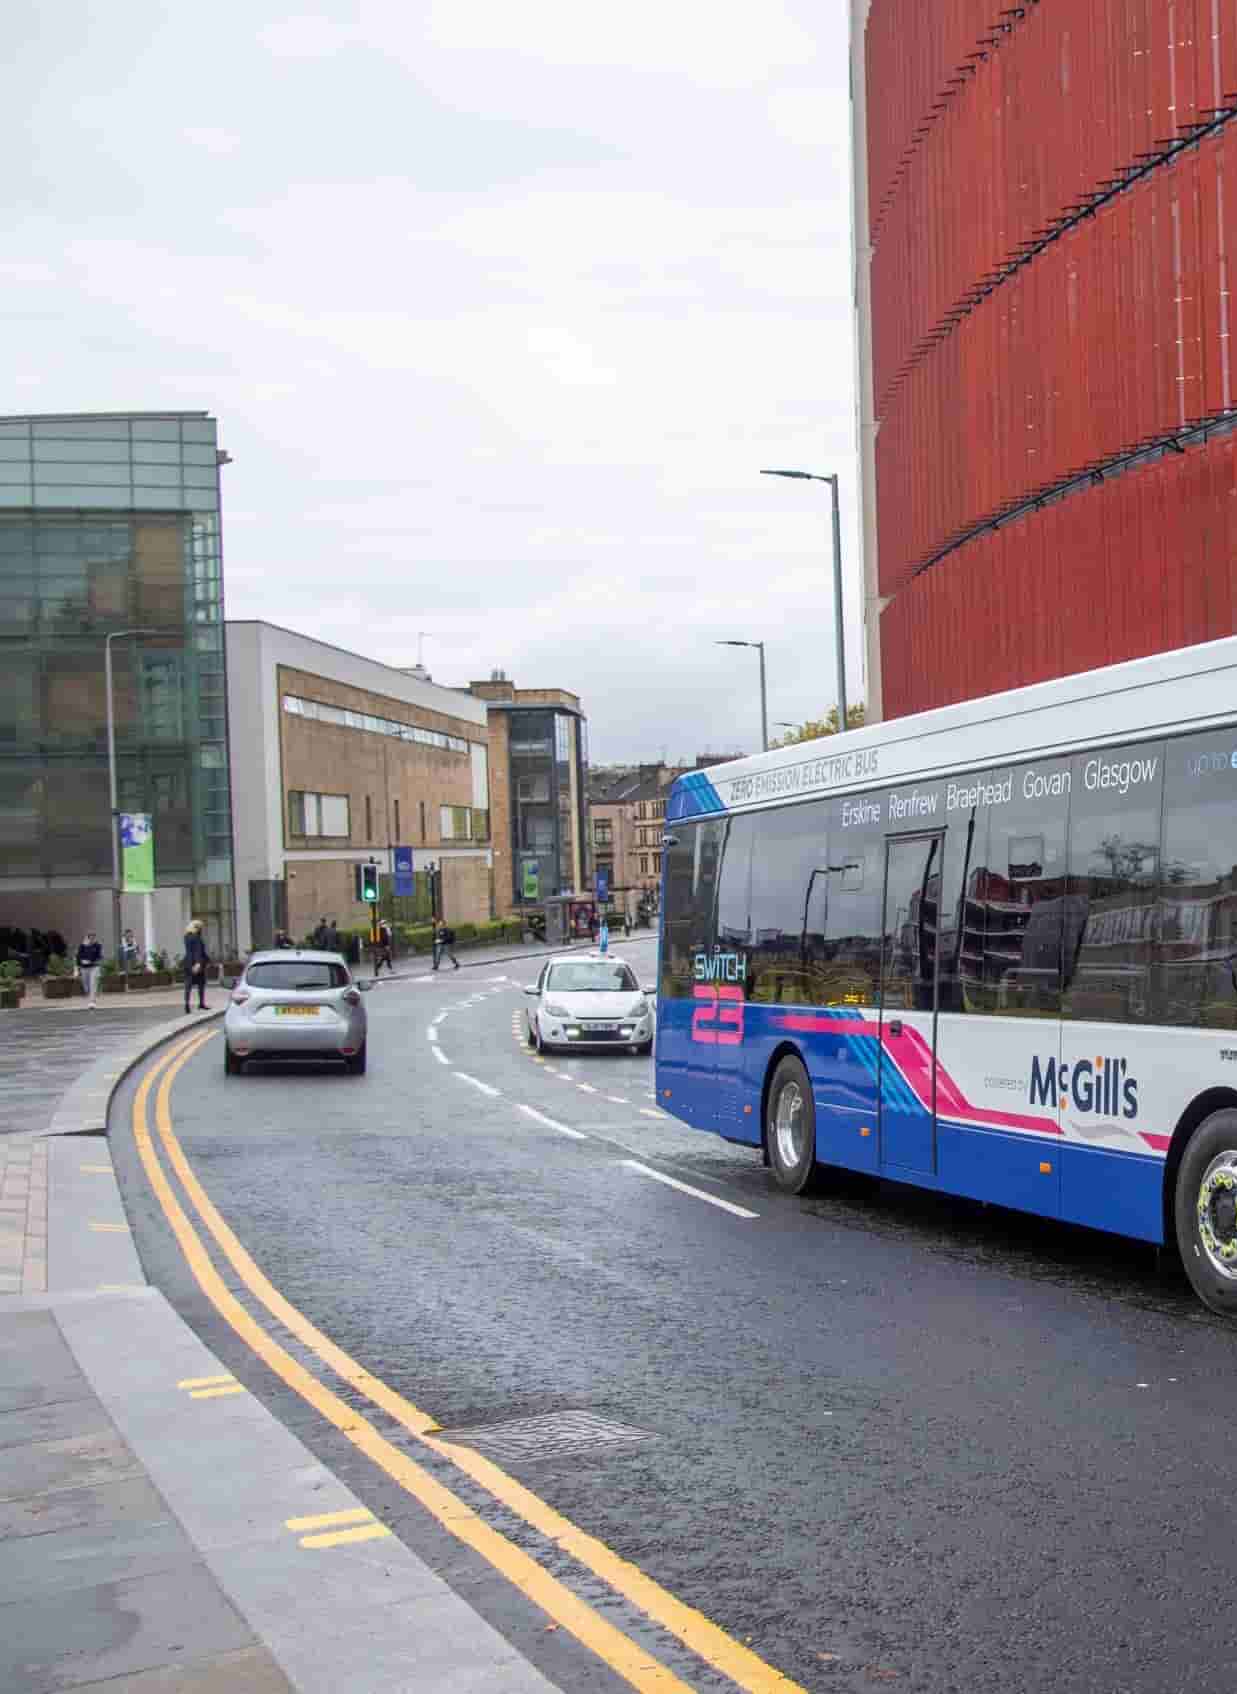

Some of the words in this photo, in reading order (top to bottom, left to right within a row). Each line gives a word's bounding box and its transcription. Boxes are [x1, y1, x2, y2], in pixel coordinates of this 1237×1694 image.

[730, 778, 753, 801] ZERO
[754, 766, 801, 797] EMISSION
[801, 755, 852, 787] ELECTRIC
[854, 750, 879, 777] BUS
[840, 801, 881, 829] Erskine
[888, 790, 938, 821] Renfrew
[945, 772, 1012, 811] Braehead
[1023, 768, 1071, 800] Govan
[1084, 756, 1157, 794] Glasgow
[1029, 1055, 1138, 1119] McGill's
